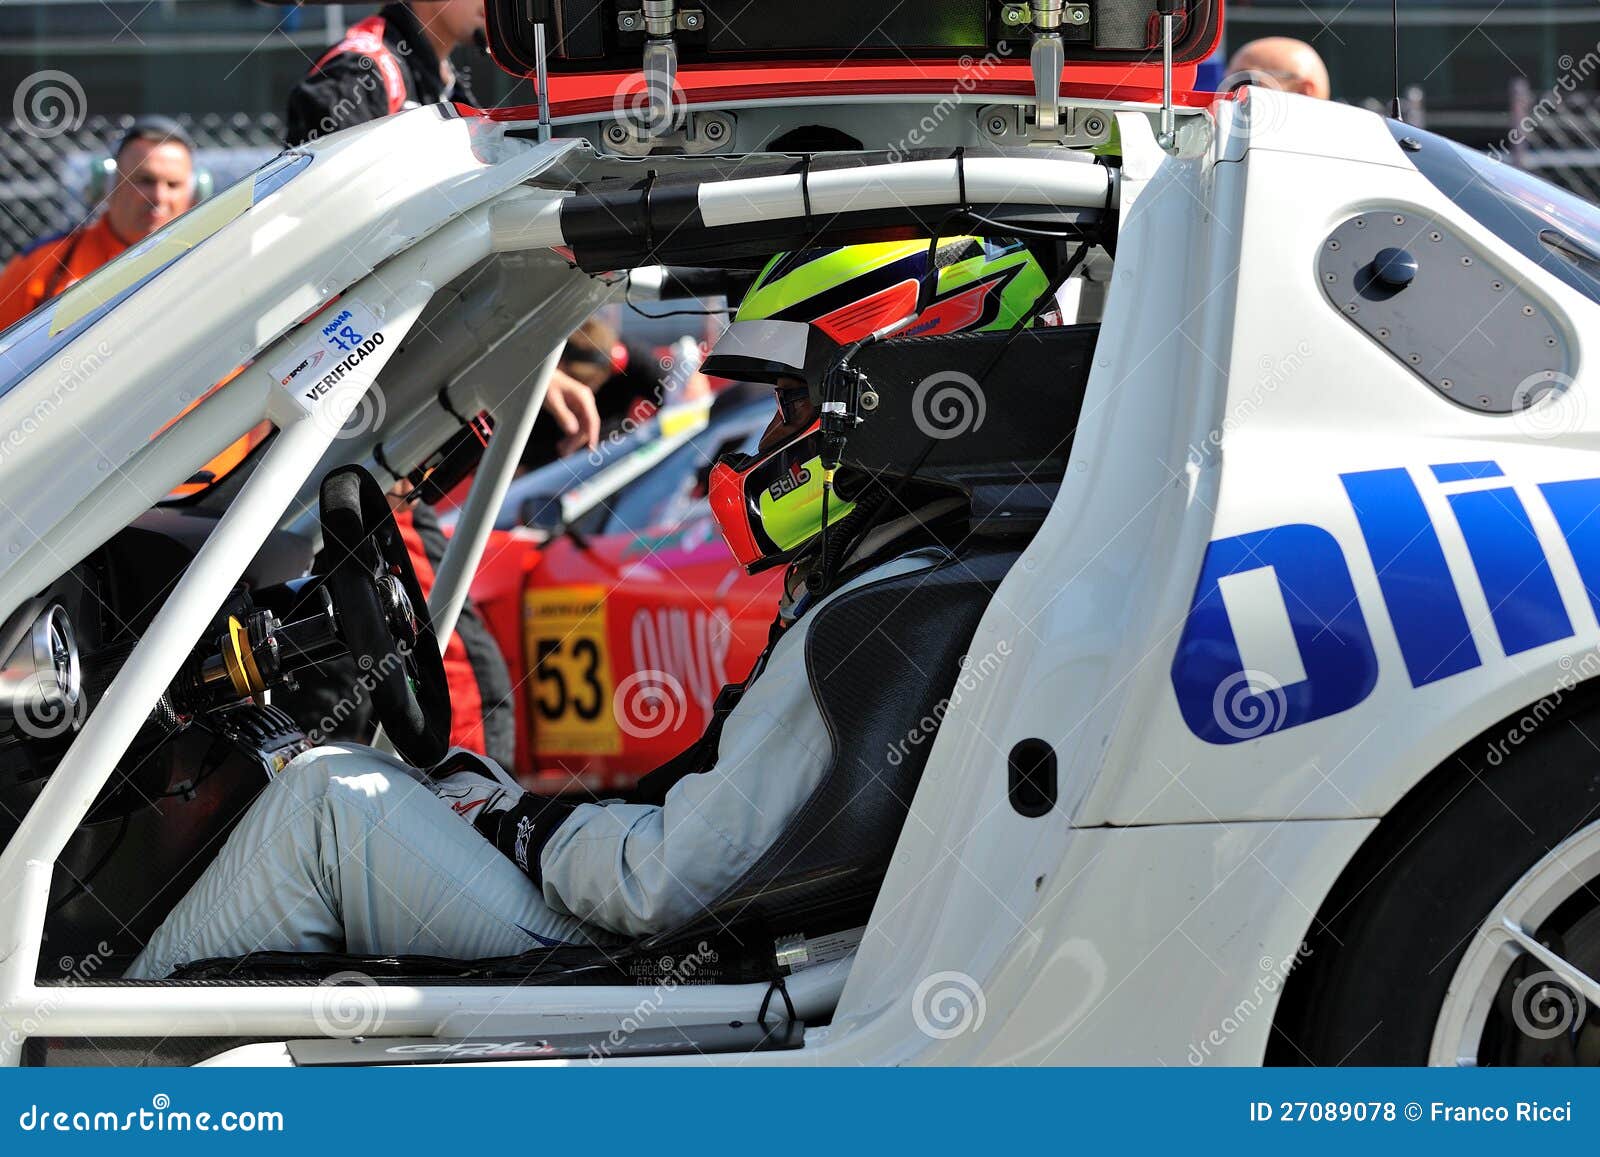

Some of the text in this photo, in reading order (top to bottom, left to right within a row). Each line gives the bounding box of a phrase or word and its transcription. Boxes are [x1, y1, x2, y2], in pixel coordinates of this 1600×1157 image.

[305, 331, 385, 401] VERIFICADO
[328, 325, 363, 351] 78
[536, 638, 604, 722] 53
